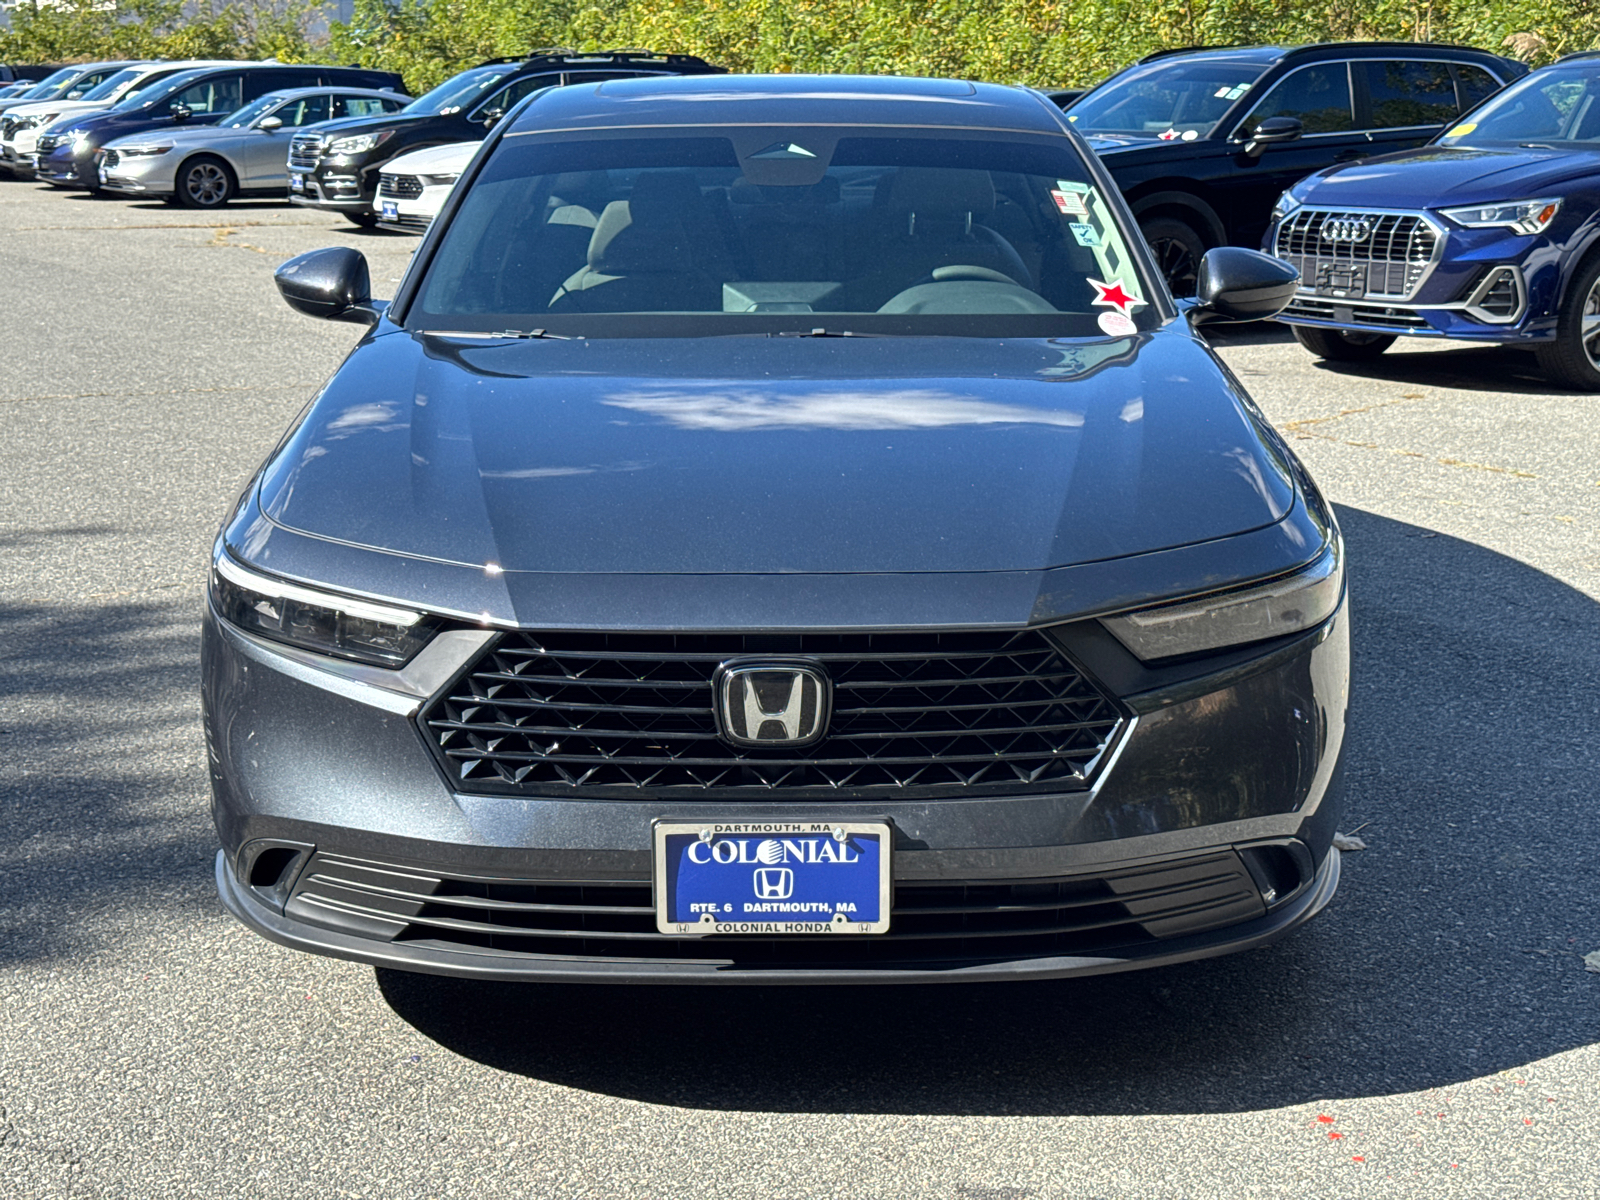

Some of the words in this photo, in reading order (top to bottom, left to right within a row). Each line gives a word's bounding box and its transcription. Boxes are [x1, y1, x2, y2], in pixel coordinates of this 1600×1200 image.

[714, 824, 806, 832] DARTMOUTH,
[810, 824, 831, 832] MA
[690, 903, 721, 913] RTE.
[723, 903, 733, 913] 6
[743, 903, 833, 914] DARTMOUTH,
[836, 903, 857, 913] MA
[715, 923, 780, 932] COLONIAL
[785, 923, 832, 932] HONDA
